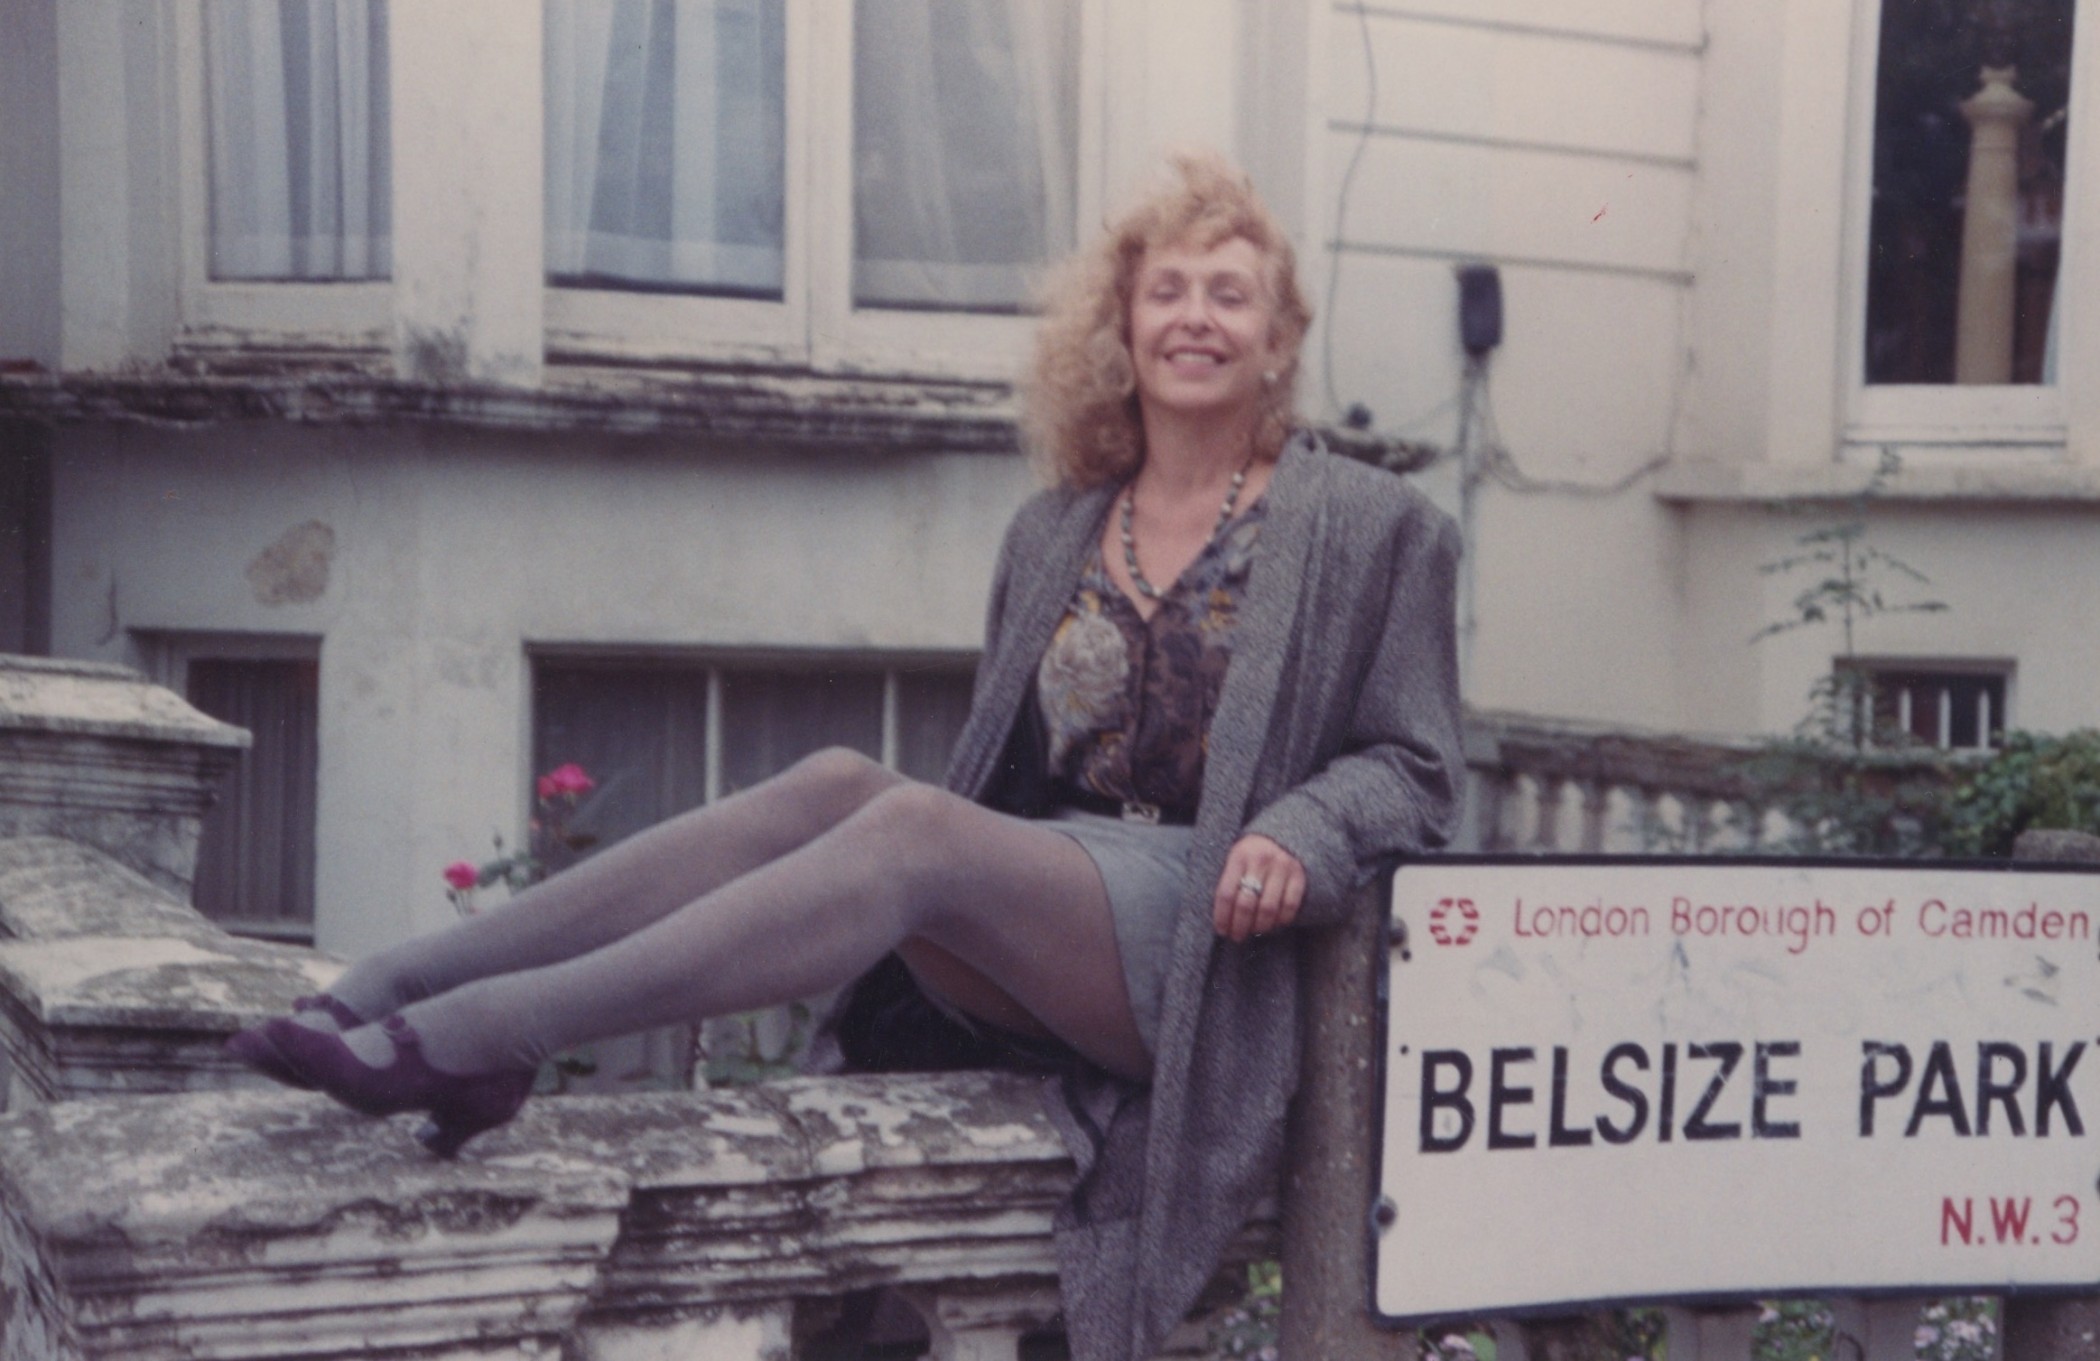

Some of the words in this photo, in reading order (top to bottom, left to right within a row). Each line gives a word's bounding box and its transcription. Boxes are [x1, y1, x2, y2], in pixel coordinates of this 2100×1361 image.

[1514, 899, 1651, 939] London
[1671, 898, 1836, 955] Borough
[1857, 899, 1896, 938] of
[1918, 899, 2090, 940] Camden
[1419, 1041, 1802, 1154] BELSIZE
[1858, 1039, 2088, 1138] PARK
[1940, 1195, 2081, 1246] N.W.3
